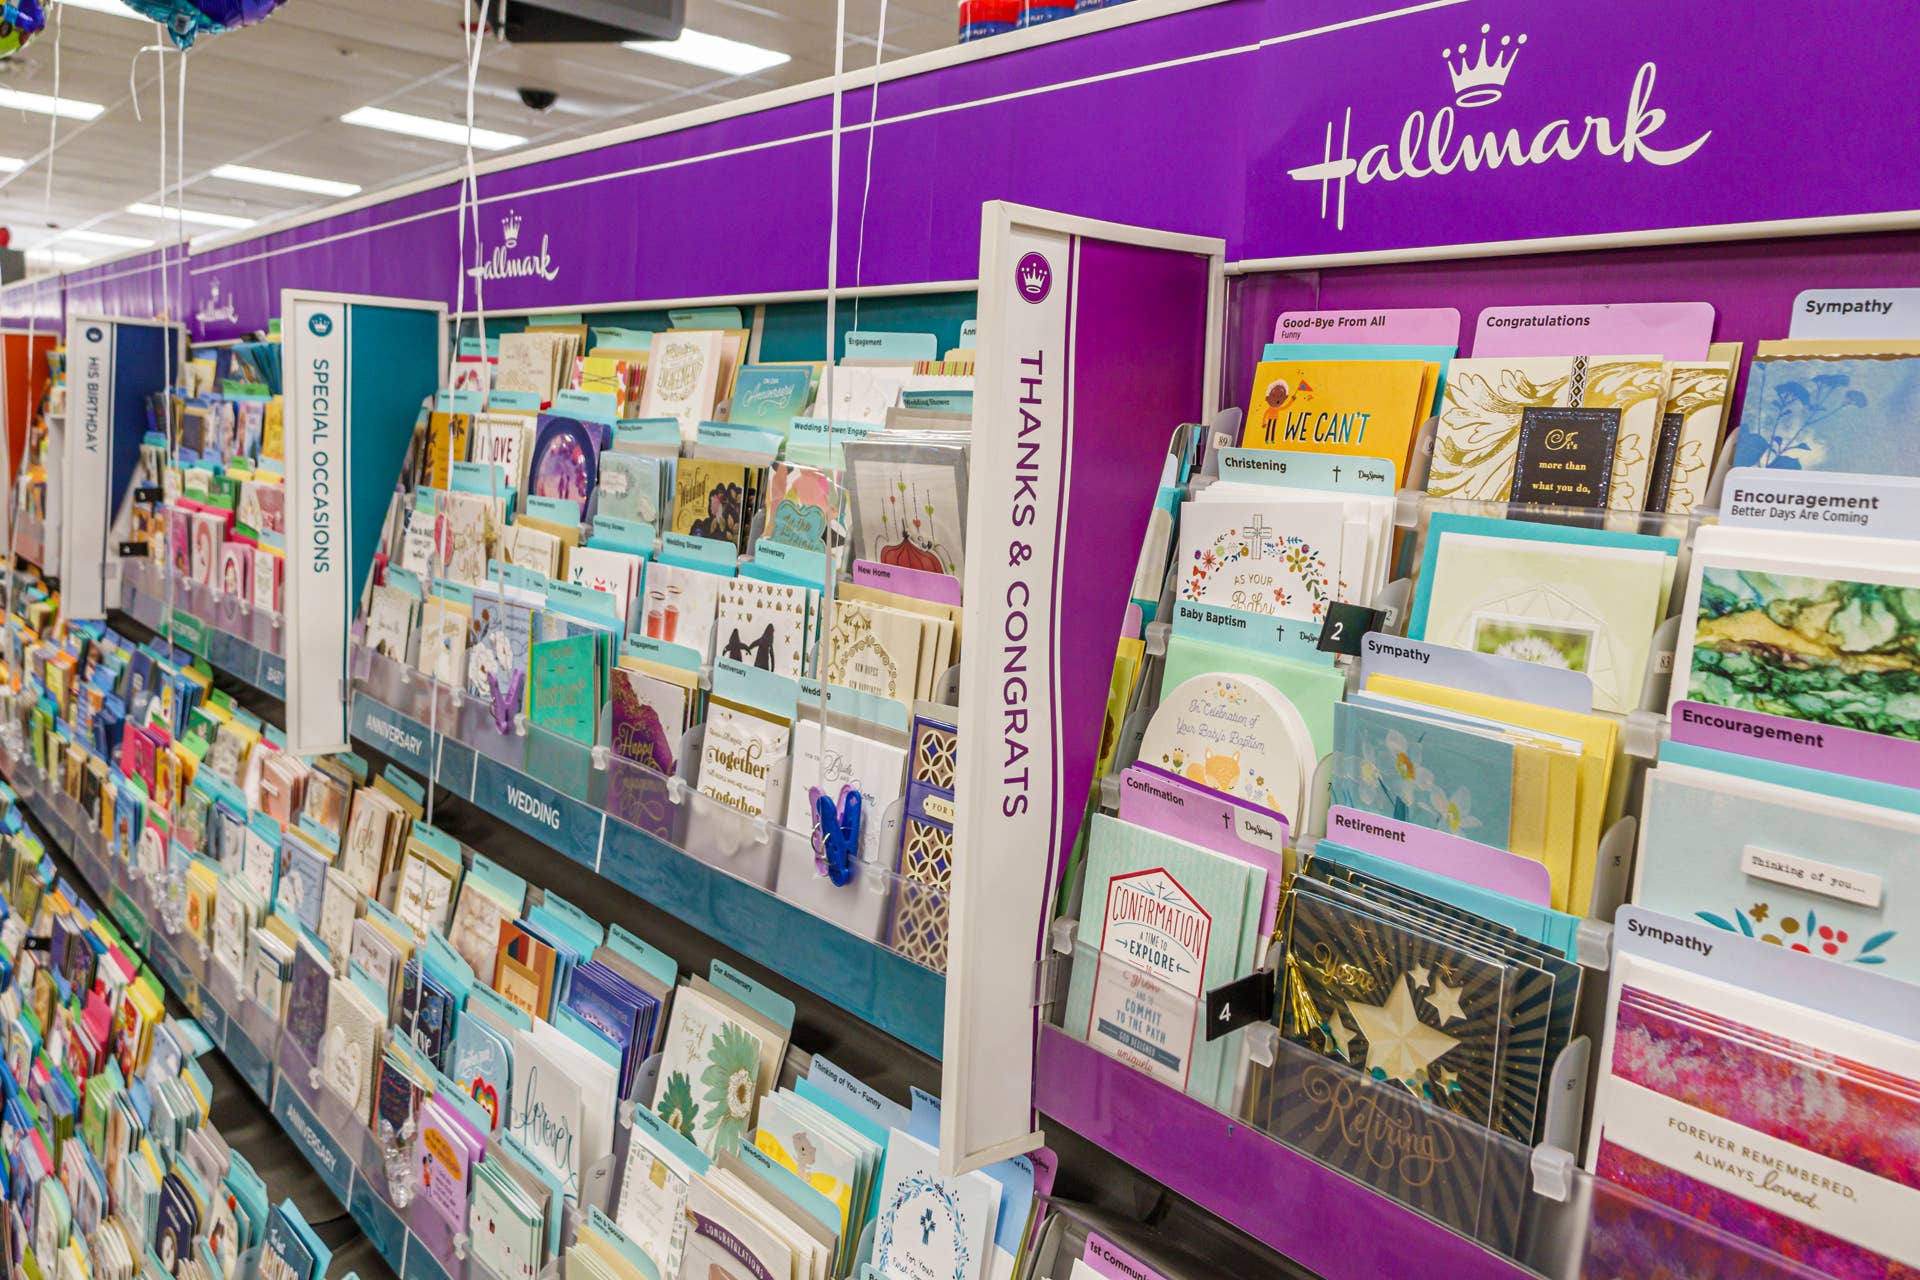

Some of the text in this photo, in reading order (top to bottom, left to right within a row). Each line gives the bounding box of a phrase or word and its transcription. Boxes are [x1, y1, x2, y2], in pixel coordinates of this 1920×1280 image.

[1287, 62, 1712, 231] Hallmark
[467, 234, 559, 296] Hallmark
[1805, 300, 1893, 315] Sympathy
[1281, 330, 1301, 341] Funny
[1282, 316, 1386, 330] Good-Bye From All
[1486, 316, 1591, 329] Congratulations
[85, 356, 99, 453] HIS BIRTHDAY
[794, 422, 822, 433] Wedding
[823, 425, 846, 434] Sower
[1284, 411, 1371, 445] WE CAN'T
[1545, 429, 1578, 450] It's
[488, 437, 513, 463] OVE
[312, 359, 330, 574] SPECIAL OCCASIONS
[1224, 457, 1287, 474] Christening
[1539, 461, 1587, 471] more than
[1532, 481, 1591, 494] what you do,
[1733, 489, 1880, 510] Encouragement
[1731, 504, 1869, 526] Better Days Are Coming
[758, 545, 785, 559] Anniversary
[858, 565, 891, 579] New Home
[1002, 350, 1042, 818] THANKS & CONGRATS
[1233, 574, 1273, 586] AS YOUR
[1180, 607, 1247, 629] Baby Baptism
[1331, 621, 1344, 641] 2
[1367, 640, 1430, 663] Sympathy
[718, 661, 746, 677] Anniversary
[801, 685, 832, 701] Weddg
[1188, 699, 1260, 728] In Celebration of
[366, 713, 423, 755] ANNIVERSARY
[1176, 718, 1265, 751] Your Baby's Baptism
[1682, 709, 1824, 748] Encouragement
[706, 737, 770, 779] together
[1126, 777, 1184, 807] Confirmation
[507, 784, 561, 830] WEDDING
[932, 802, 948, 815] FOR
[1244, 820, 1273, 840] DaySpring
[1335, 814, 1406, 842] Retirement
[1751, 855, 1804, 879] Thinking
[1810, 870, 1824, 882] of
[1112, 885, 1205, 959] CONFIRMATION
[1144, 933, 1159, 946] TIME
[1159, 940, 1168, 950] TO
[1627, 918, 1713, 956] Sympathy
[1129, 940, 1175, 972] EXPLORE
[723, 969, 753, 993] Anniversary
[1124, 1000, 1162, 1026] COMMIT
[1219, 1003, 1232, 1022] 4
[1117, 1011, 1167, 1044] TO THE PATH
[1116, 1048, 1154, 1071] uniquely
[814, 1060, 838, 1083] Thinking
[838, 1077, 845, 1087] of
[846, 1082, 858, 1095] You
[862, 1091, 882, 1110] Funny
[287, 1104, 337, 1172] ANNIVERSARY
[511, 1065, 578, 1190] forever
[1302, 1065, 1455, 1187] Retiring
[1667, 1116, 1737, 1153] FOREVER
[743, 1143, 771, 1168] Wedding
[1694, 1151, 1755, 1183] ALWAYS
[704, 1223, 764, 1280] CONGRATULATIONS
[1089, 1241, 1101, 1257] 1st
[906, 1251, 935, 1278] For Your
